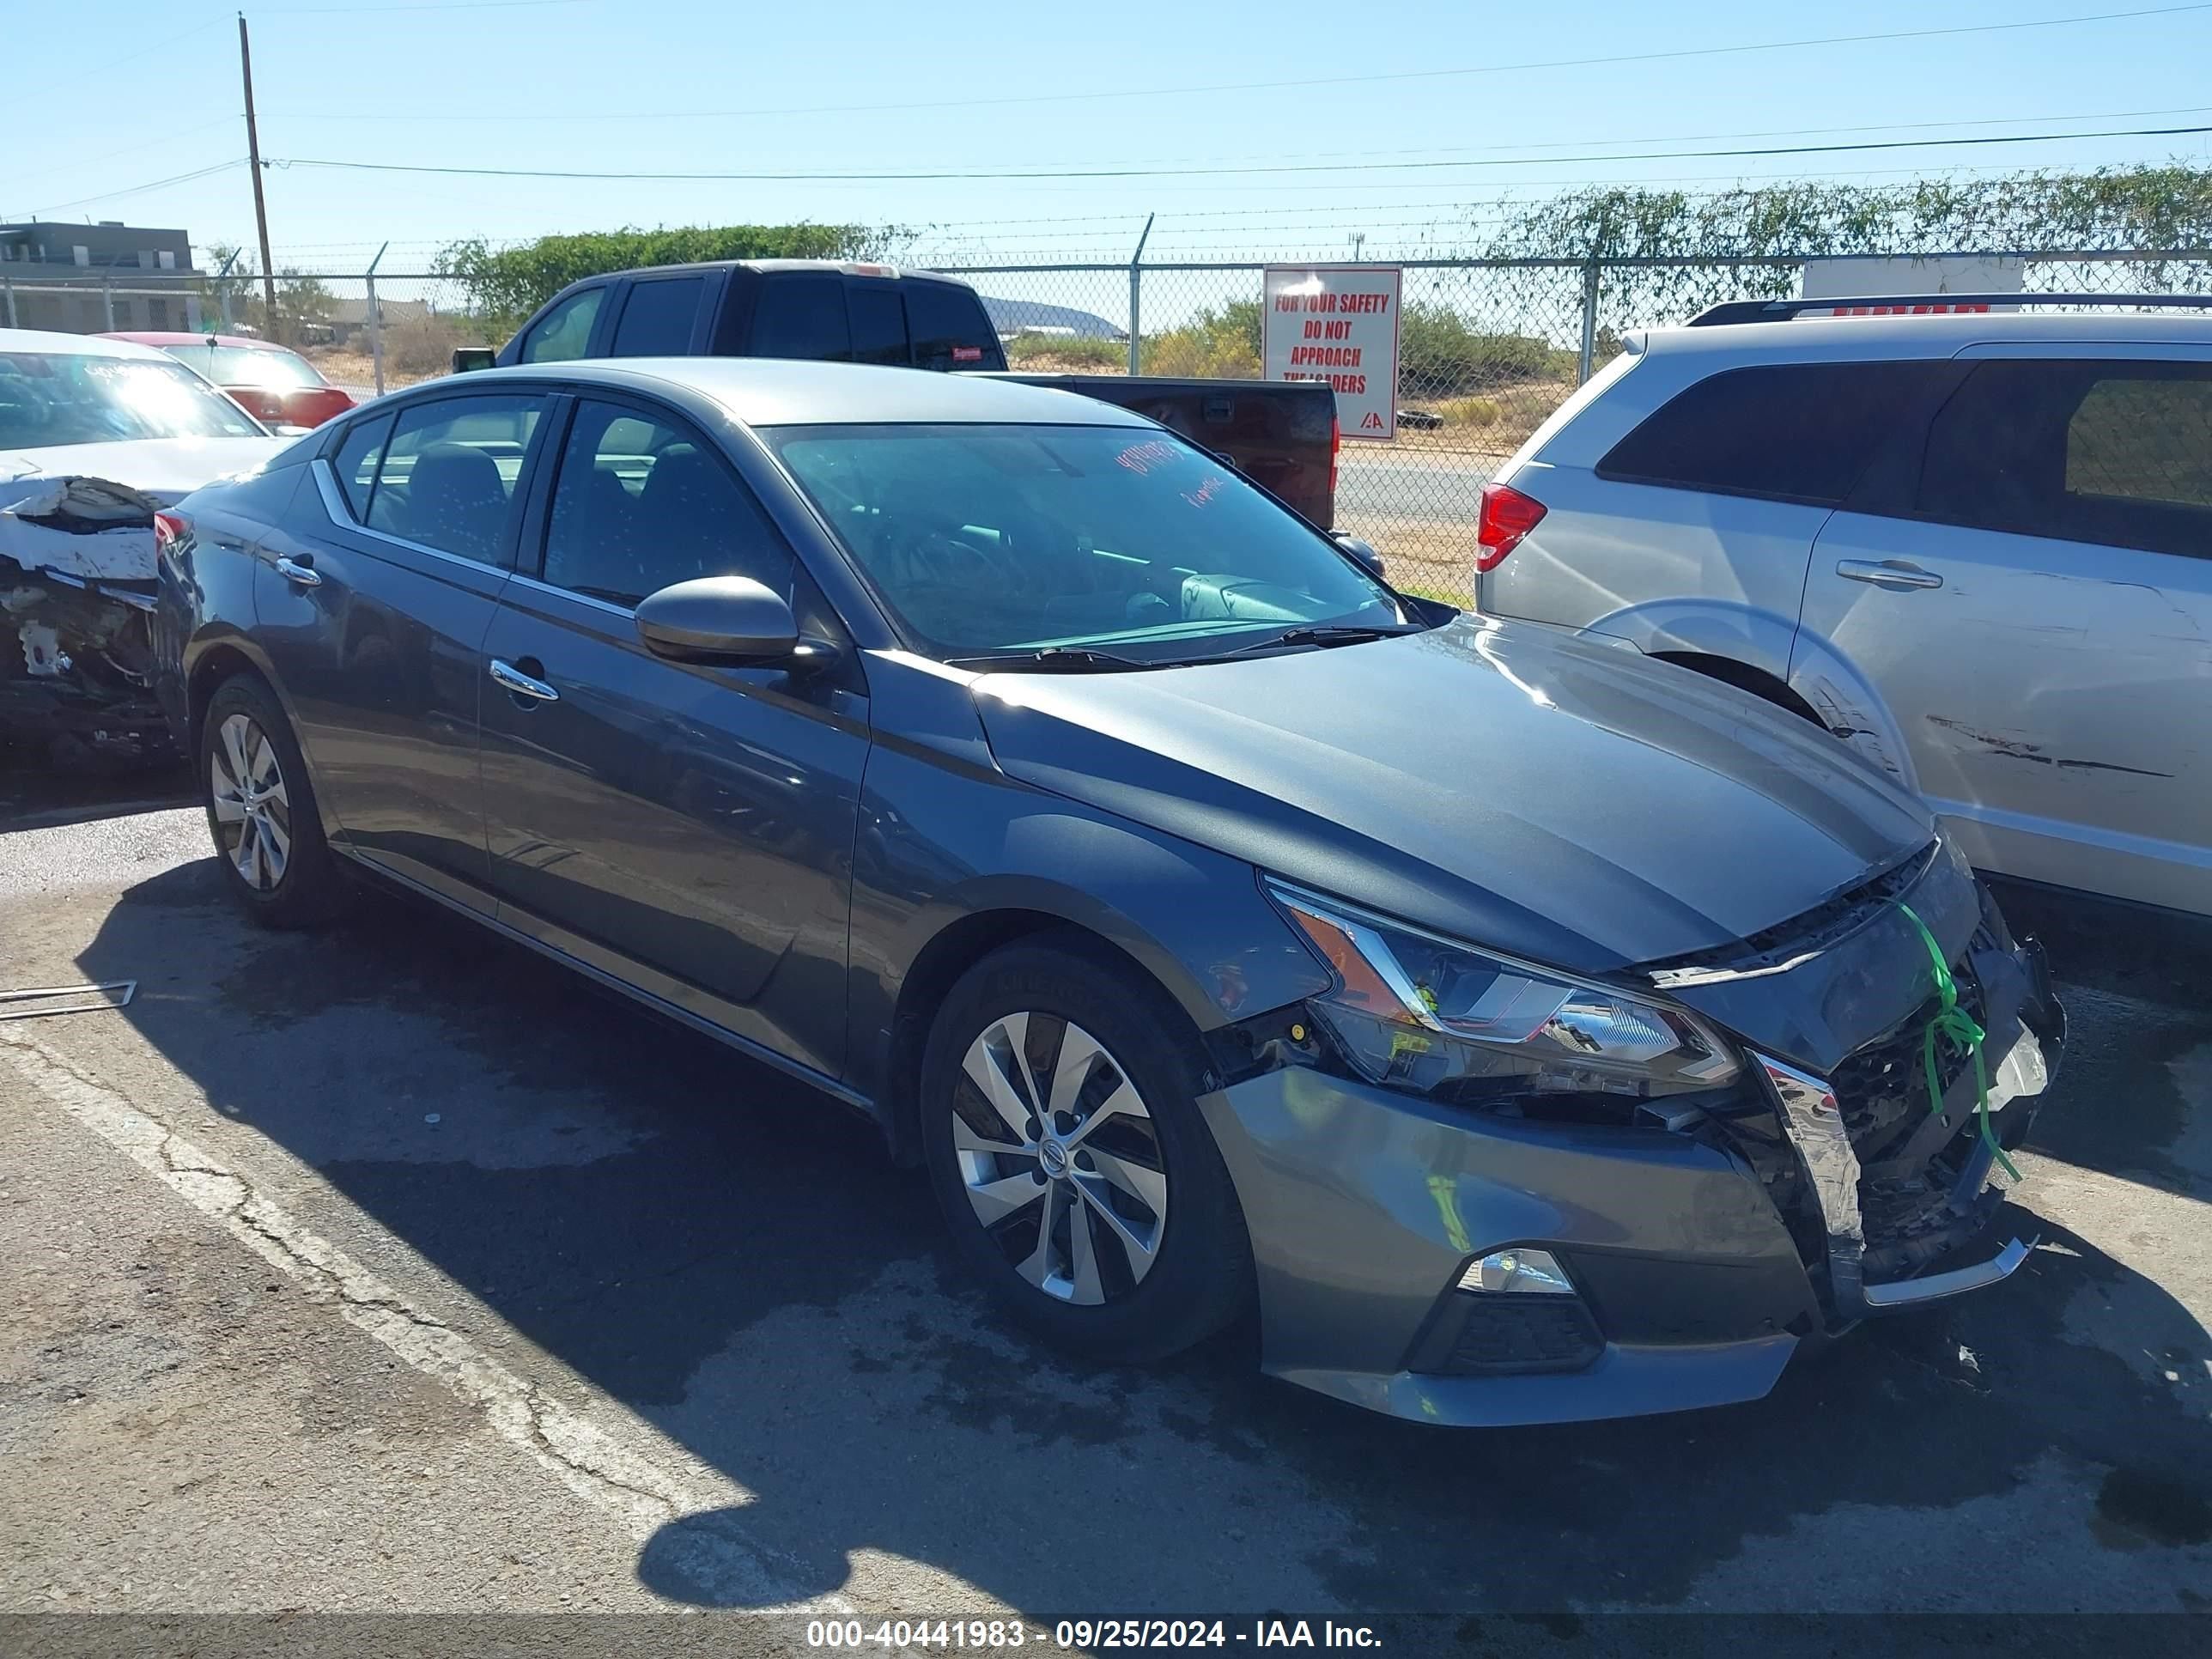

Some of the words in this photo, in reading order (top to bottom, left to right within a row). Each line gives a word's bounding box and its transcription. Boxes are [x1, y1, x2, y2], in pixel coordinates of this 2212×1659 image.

[1275, 294, 1298, 313] FOR
[1302, 294, 1336, 313] YOUR
[1340, 294, 1389, 313] SAFETY
[1304, 320, 1322, 339] DO
[1325, 321, 1352, 340] NOT
[1291, 346, 1362, 368] APPROACH
